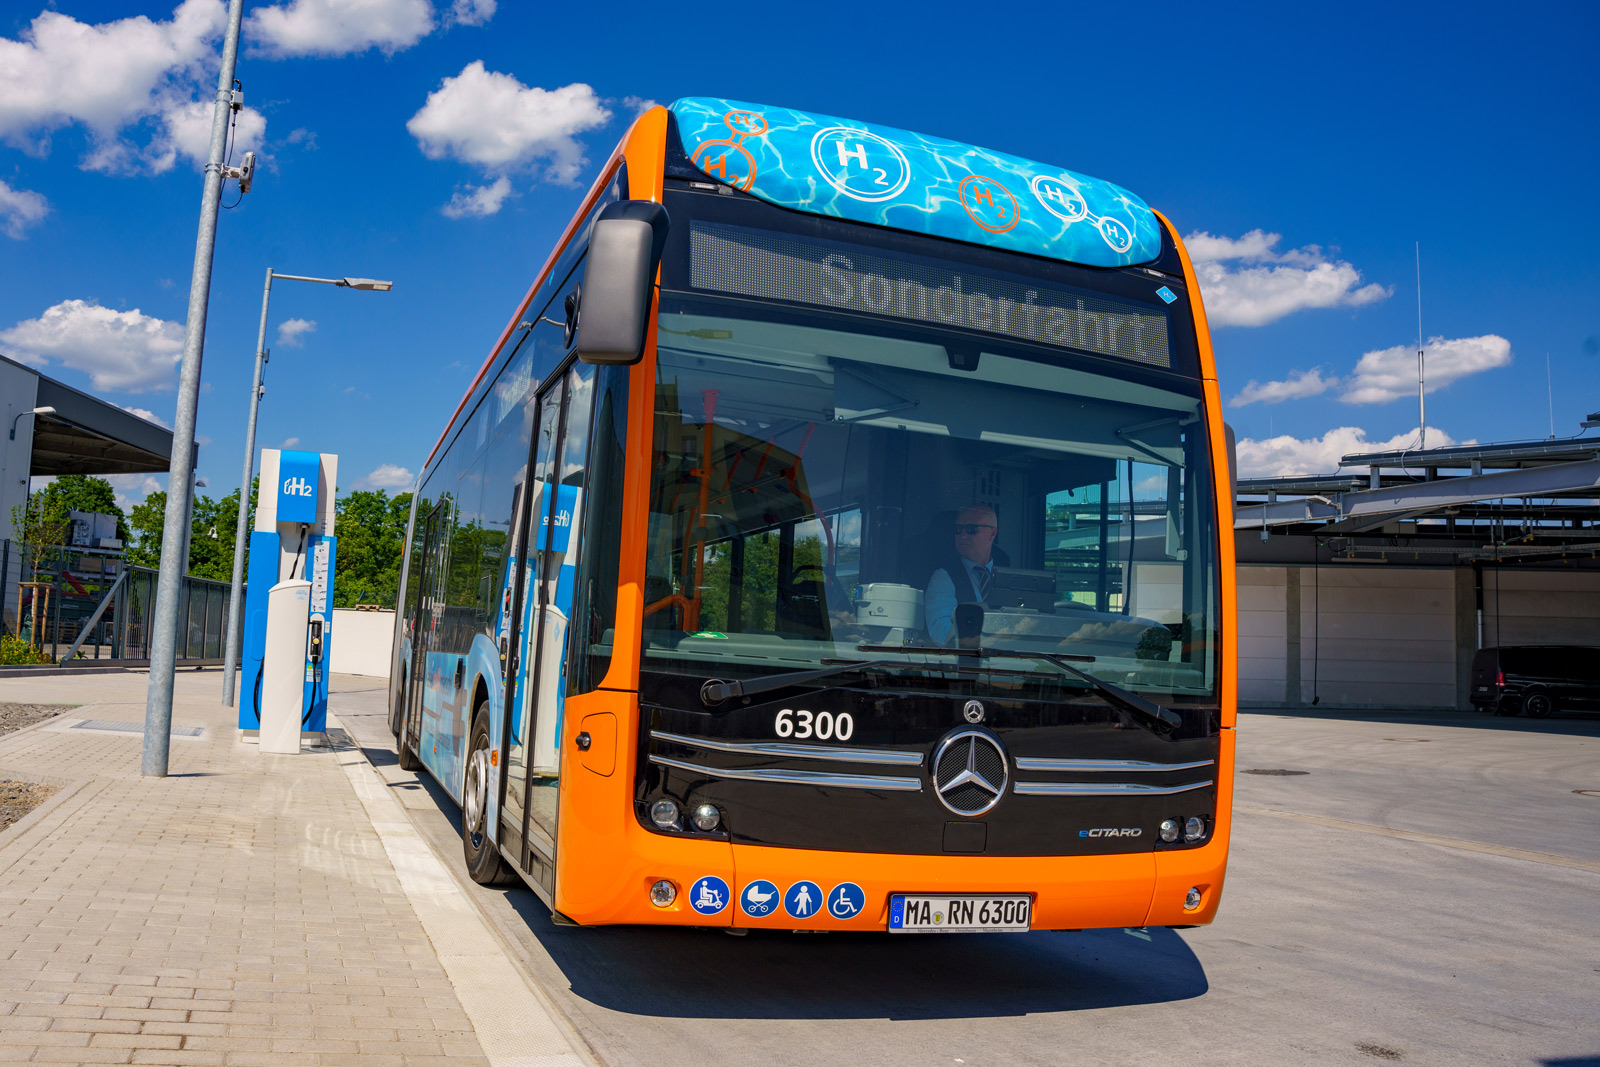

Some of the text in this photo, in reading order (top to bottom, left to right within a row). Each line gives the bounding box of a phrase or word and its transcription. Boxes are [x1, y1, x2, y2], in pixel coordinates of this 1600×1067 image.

[735, 115, 759, 130] H2
[836, 141, 889, 186] H2
[973, 186, 1006, 219] H2
[1044, 184, 1077, 214] H2
[1106, 223, 1125, 247] H2
[822, 253, 1147, 357] Sonderfahrt
[775, 709, 854, 741] 6300
[1078, 828, 1142, 838] eCITARO
[893, 900, 1027, 925] D MA RN 6300
